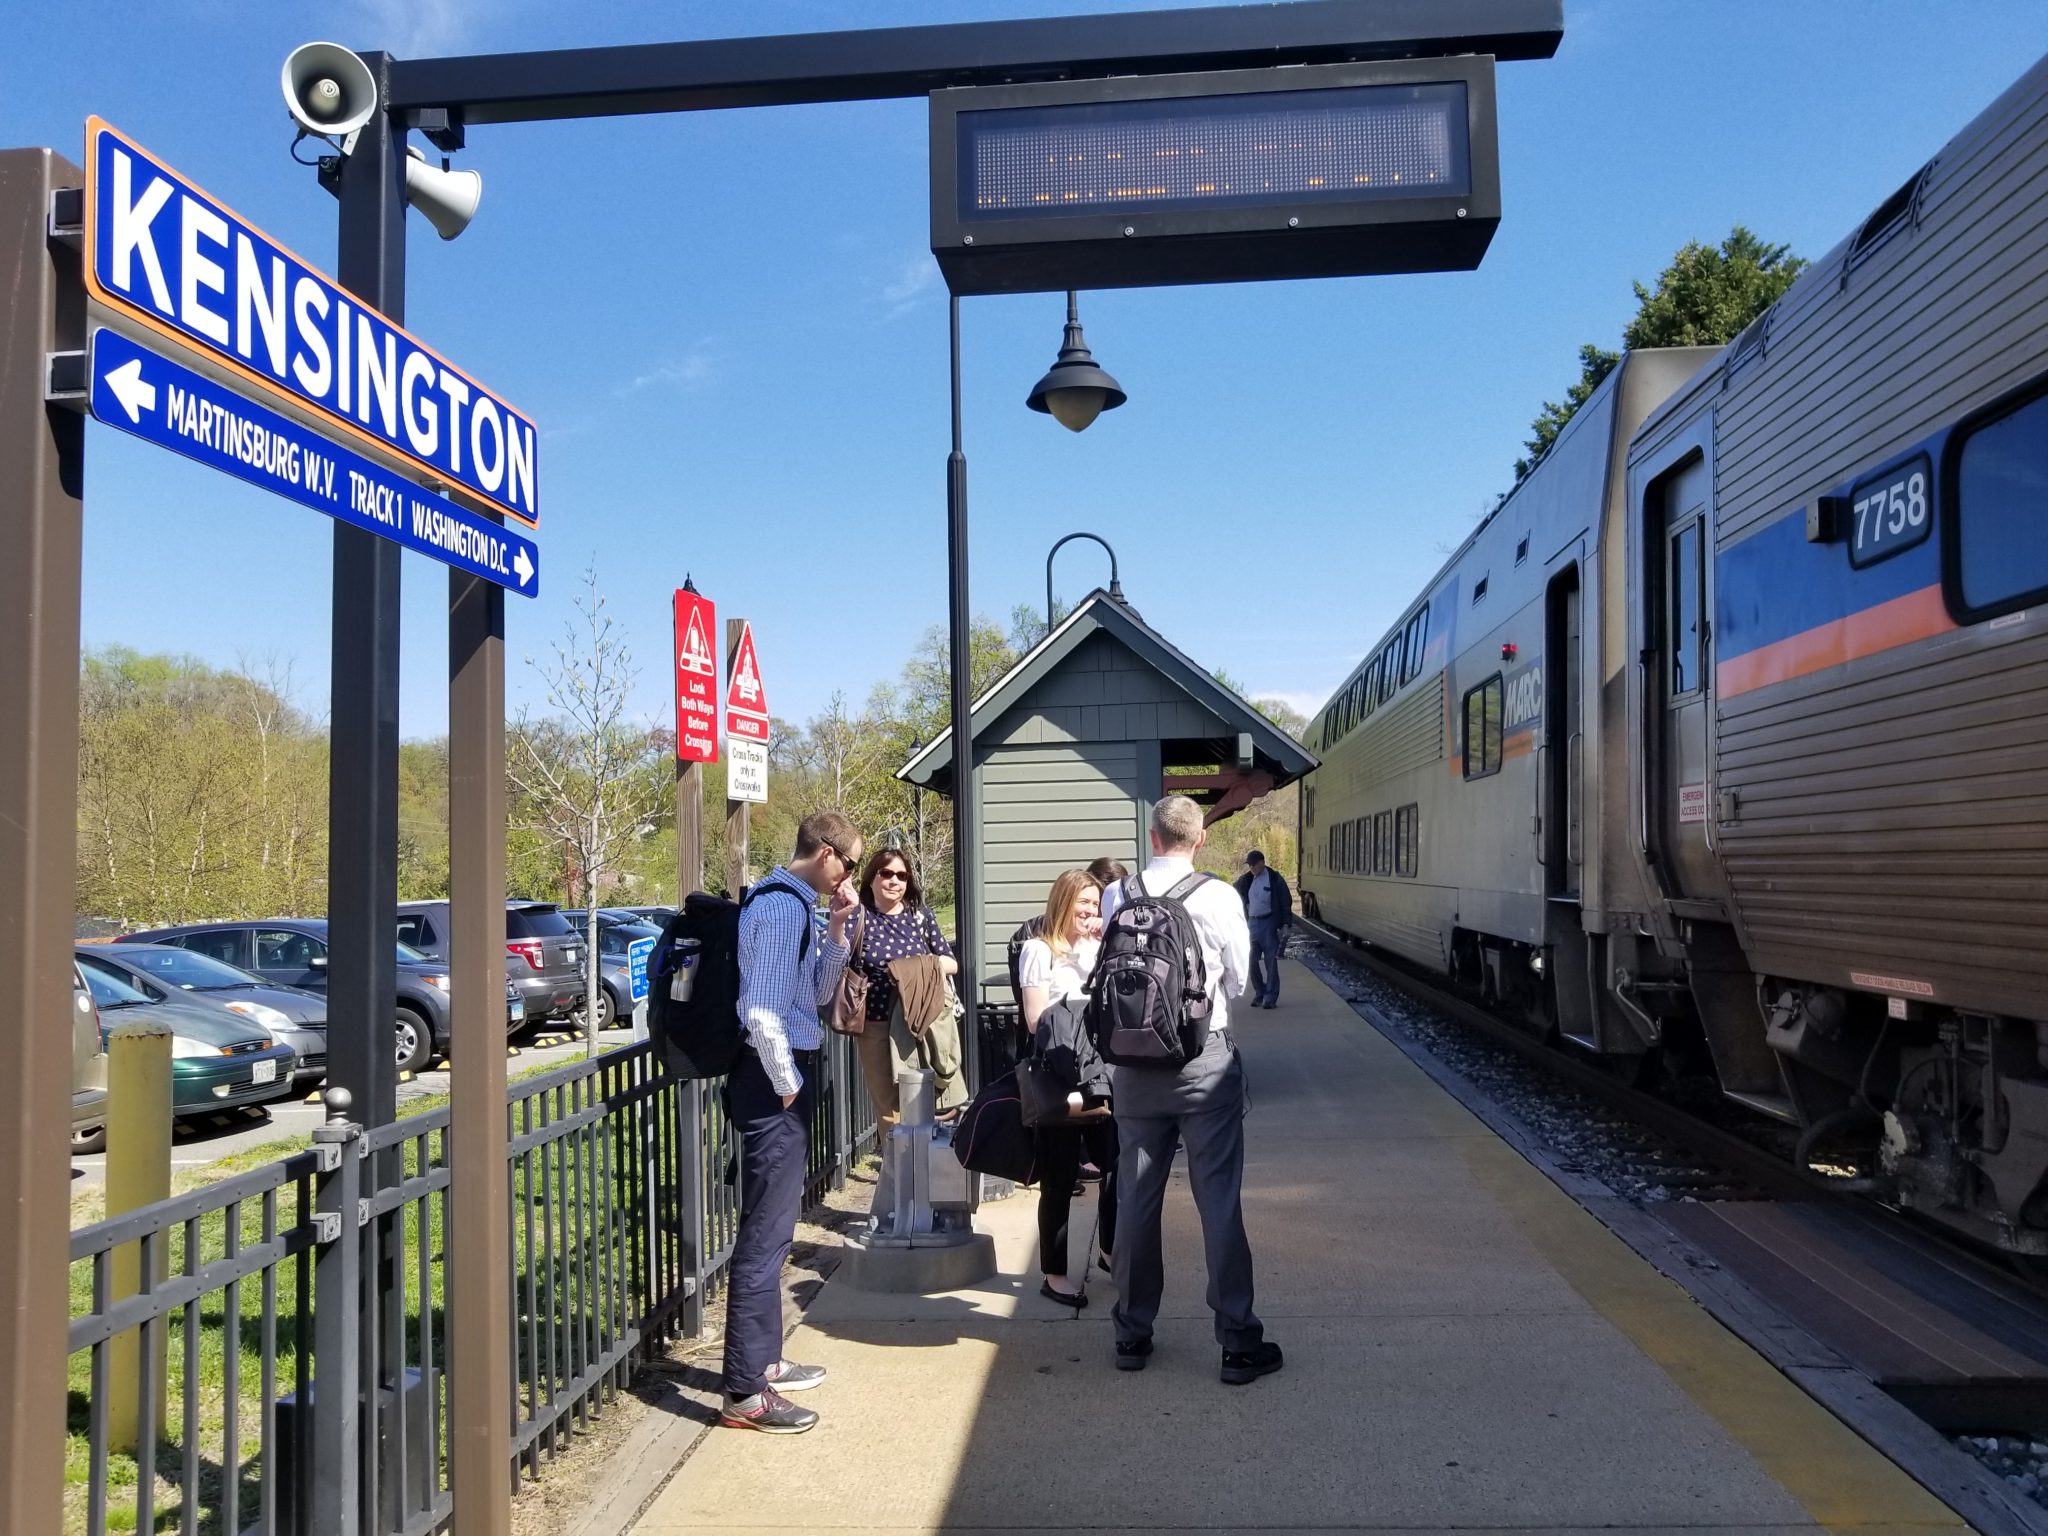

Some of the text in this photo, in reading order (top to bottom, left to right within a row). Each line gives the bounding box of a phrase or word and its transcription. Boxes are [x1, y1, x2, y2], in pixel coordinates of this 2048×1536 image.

[112, 147, 535, 513] KENSINGTON
[167, 383, 510, 576] MARTINSBURG W.V. TRACK 1 WASHINGTON D.C.
[1853, 471, 1926, 550] 7758
[689, 679, 706, 696] Look
[681, 696, 714, 716] Both Ways
[1503, 666, 1542, 730] MARC
[687, 715, 709, 731] Before
[736, 718, 760, 735] DANGER
[685, 733, 713, 758] Crossing
[732, 746, 763, 764] Cross Tracks
[740, 765, 750, 778] only
[734, 778, 761, 793] Crosswalks
[1680, 805, 1698, 817] ACCESS
